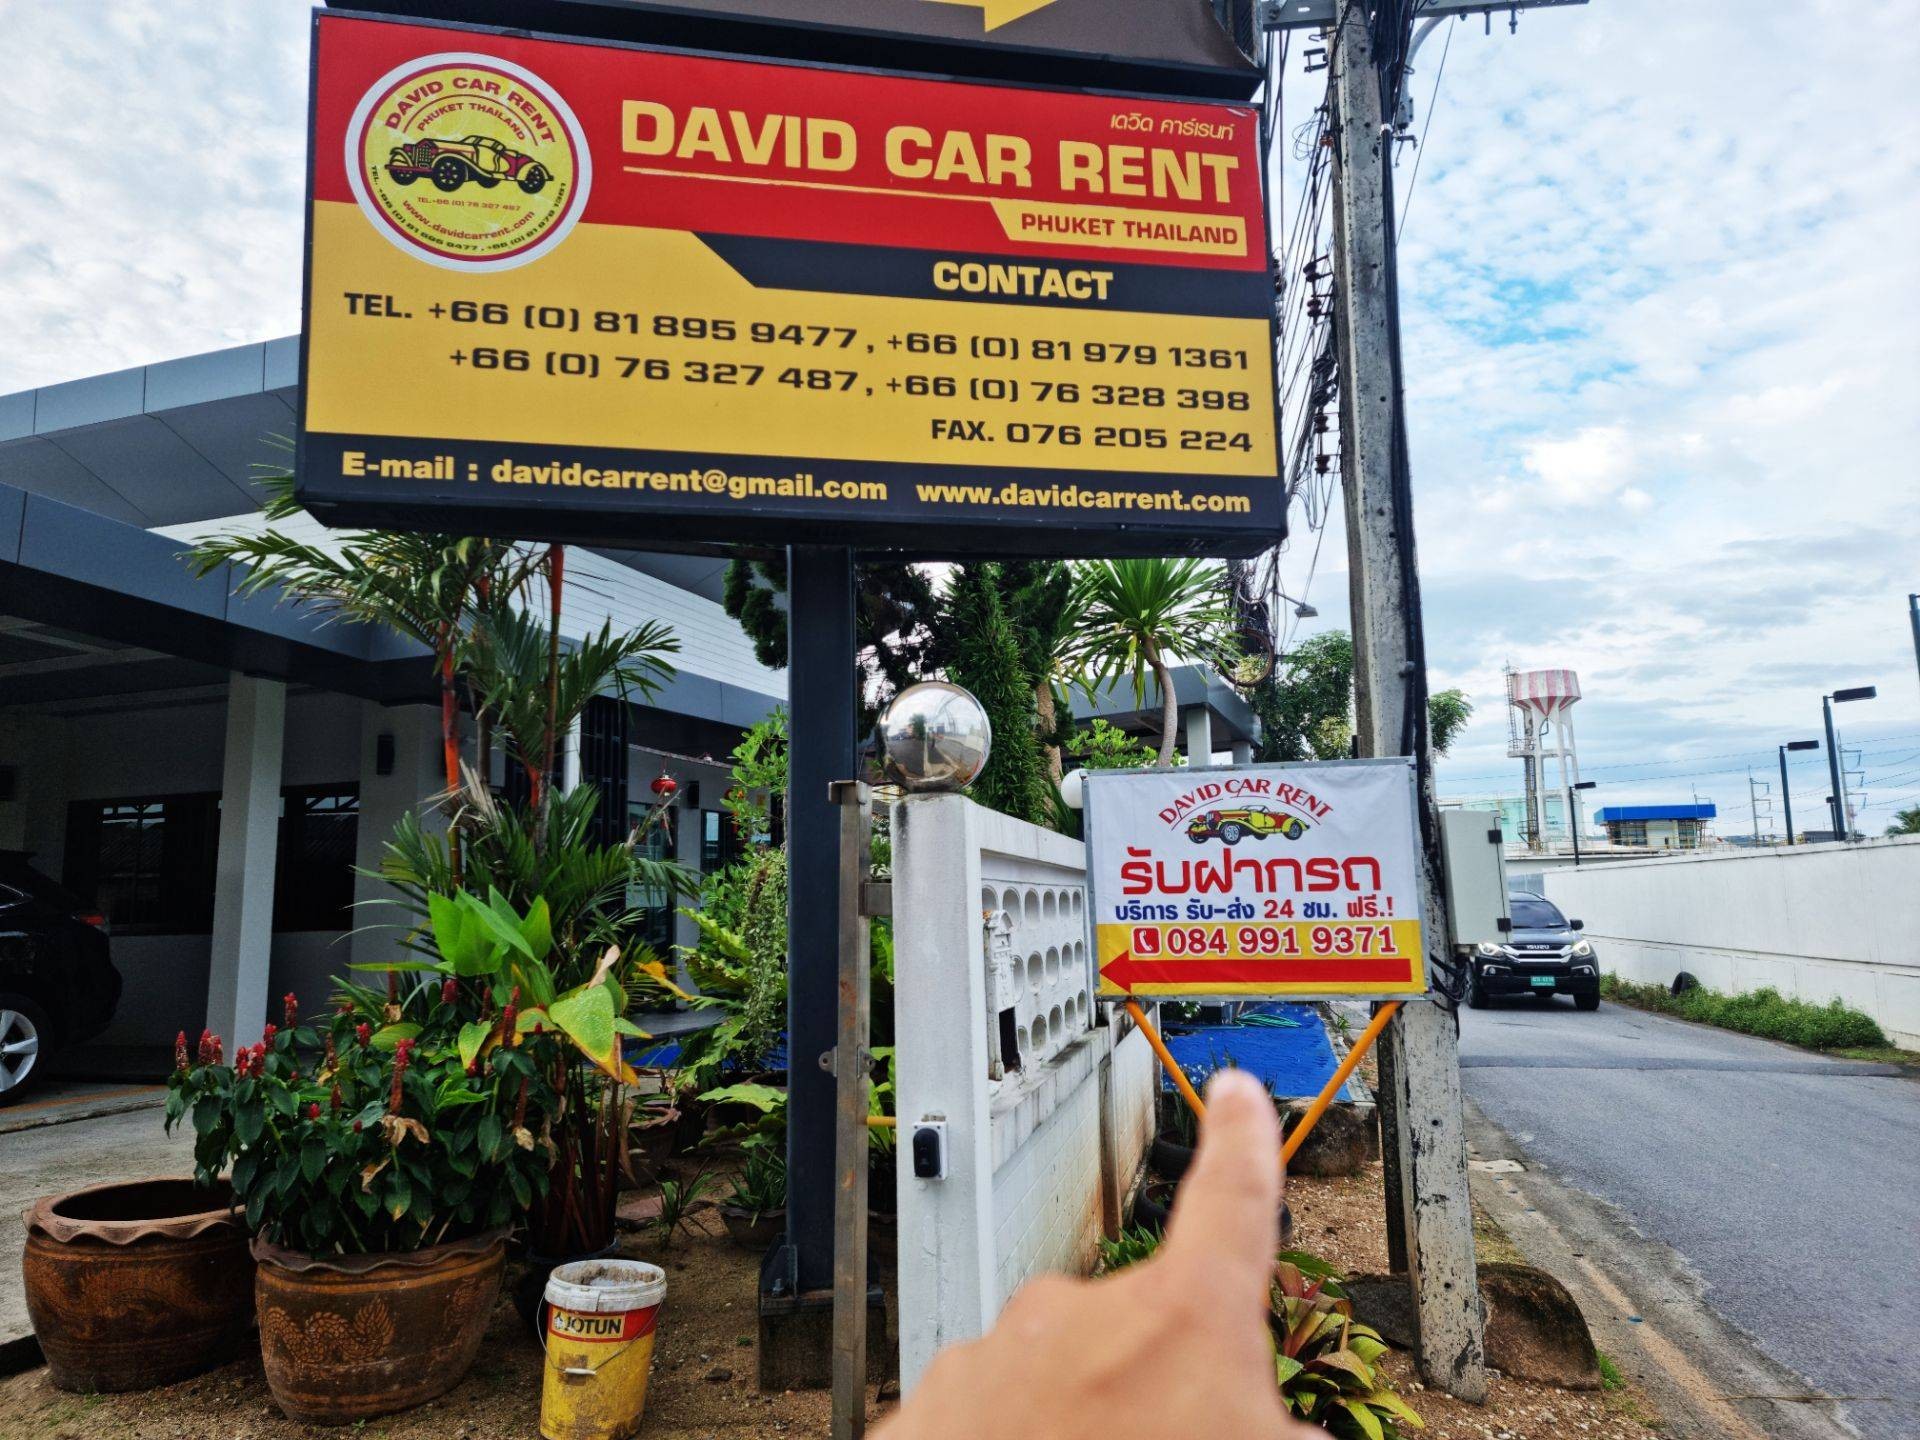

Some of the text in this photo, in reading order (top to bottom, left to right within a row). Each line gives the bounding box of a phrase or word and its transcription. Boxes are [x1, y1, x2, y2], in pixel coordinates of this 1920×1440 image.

[385, 77, 556, 142] DAVID CAR RENT
[417, 103, 526, 141] PHUKET THAILAND
[1110, 112, 1235, 141] เดวิด คาร์เรนท์
[622, 99, 1239, 203] DAVID CAR RENT
[402, 200, 535, 240] www.davidcarrent.com
[1021, 212, 1238, 245] PHUKET THAILAND
[933, 261, 1113, 300] CONTACT
[343, 292, 413, 318] TEL.
[429, 300, 508, 325] +66
[524, 305, 580, 332] (0)
[594, 312, 638, 335] 81
[653, 315, 736, 341] 895
[887, 332, 957, 355] +66
[971, 336, 1019, 360] (0)
[1032, 340, 1071, 361] 81
[1084, 344, 1157, 366] 979
[1168, 347, 1248, 370] 1361
[450, 348, 530, 372] +66
[546, 352, 600, 378] (0)
[615, 357, 670, 381] 76
[684, 361, 764, 386] 327
[886, 375, 956, 397] +66
[970, 378, 1019, 402] (0)
[1031, 381, 1080, 404] 76
[1092, 384, 1165, 408] 328
[1177, 388, 1250, 411] 398
[931, 419, 1253, 453] FAX. 076 205 224
[342, 451, 454, 481] E-mail
[491, 459, 888, 500] davidcarrent@gmail.com
[917, 482, 1252, 513] www.davidcarrent.com
[1158, 778, 1334, 825] DAVID CAR RENT
[1120, 846, 1382, 895] รับฝากรถ
[1115, 900, 1179, 920] บริการ
[1186, 897, 1255, 920] รับ-ส่ง
[1264, 899, 1294, 918] 24
[1303, 901, 1338, 918] ชม.
[1166, 926, 1396, 954] 084 991 9371
[565, 1316, 622, 1335] JOTUN
